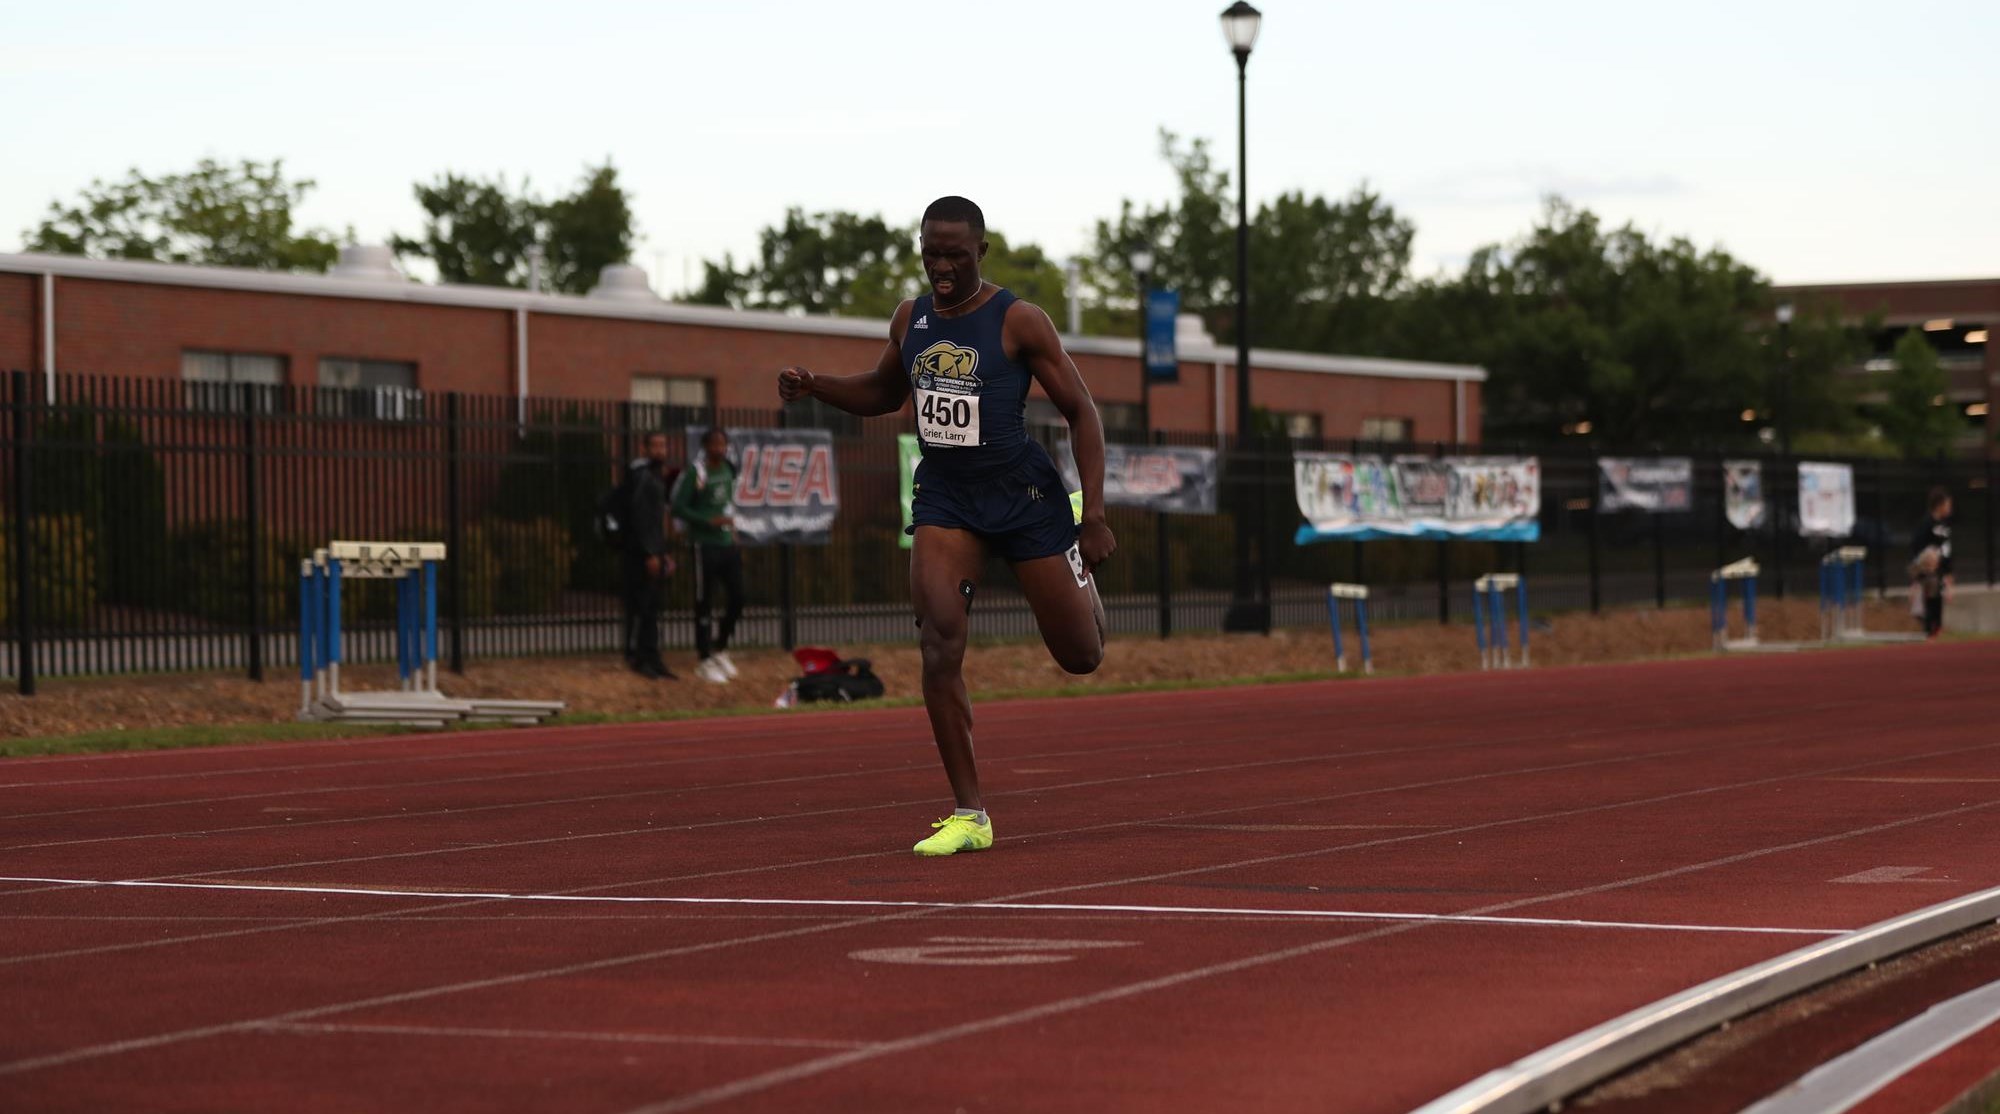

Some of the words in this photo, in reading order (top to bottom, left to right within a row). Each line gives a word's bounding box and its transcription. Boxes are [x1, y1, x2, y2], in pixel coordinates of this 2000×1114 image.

[934, 376, 964, 386] CONFERENCE
[936, 386, 971, 395] CHAMPIONSHIPS
[922, 395, 970, 428] 450
[924, 428, 943, 440] Grier,
[945, 430, 966, 443] Larry
[734, 443, 837, 507] USA
